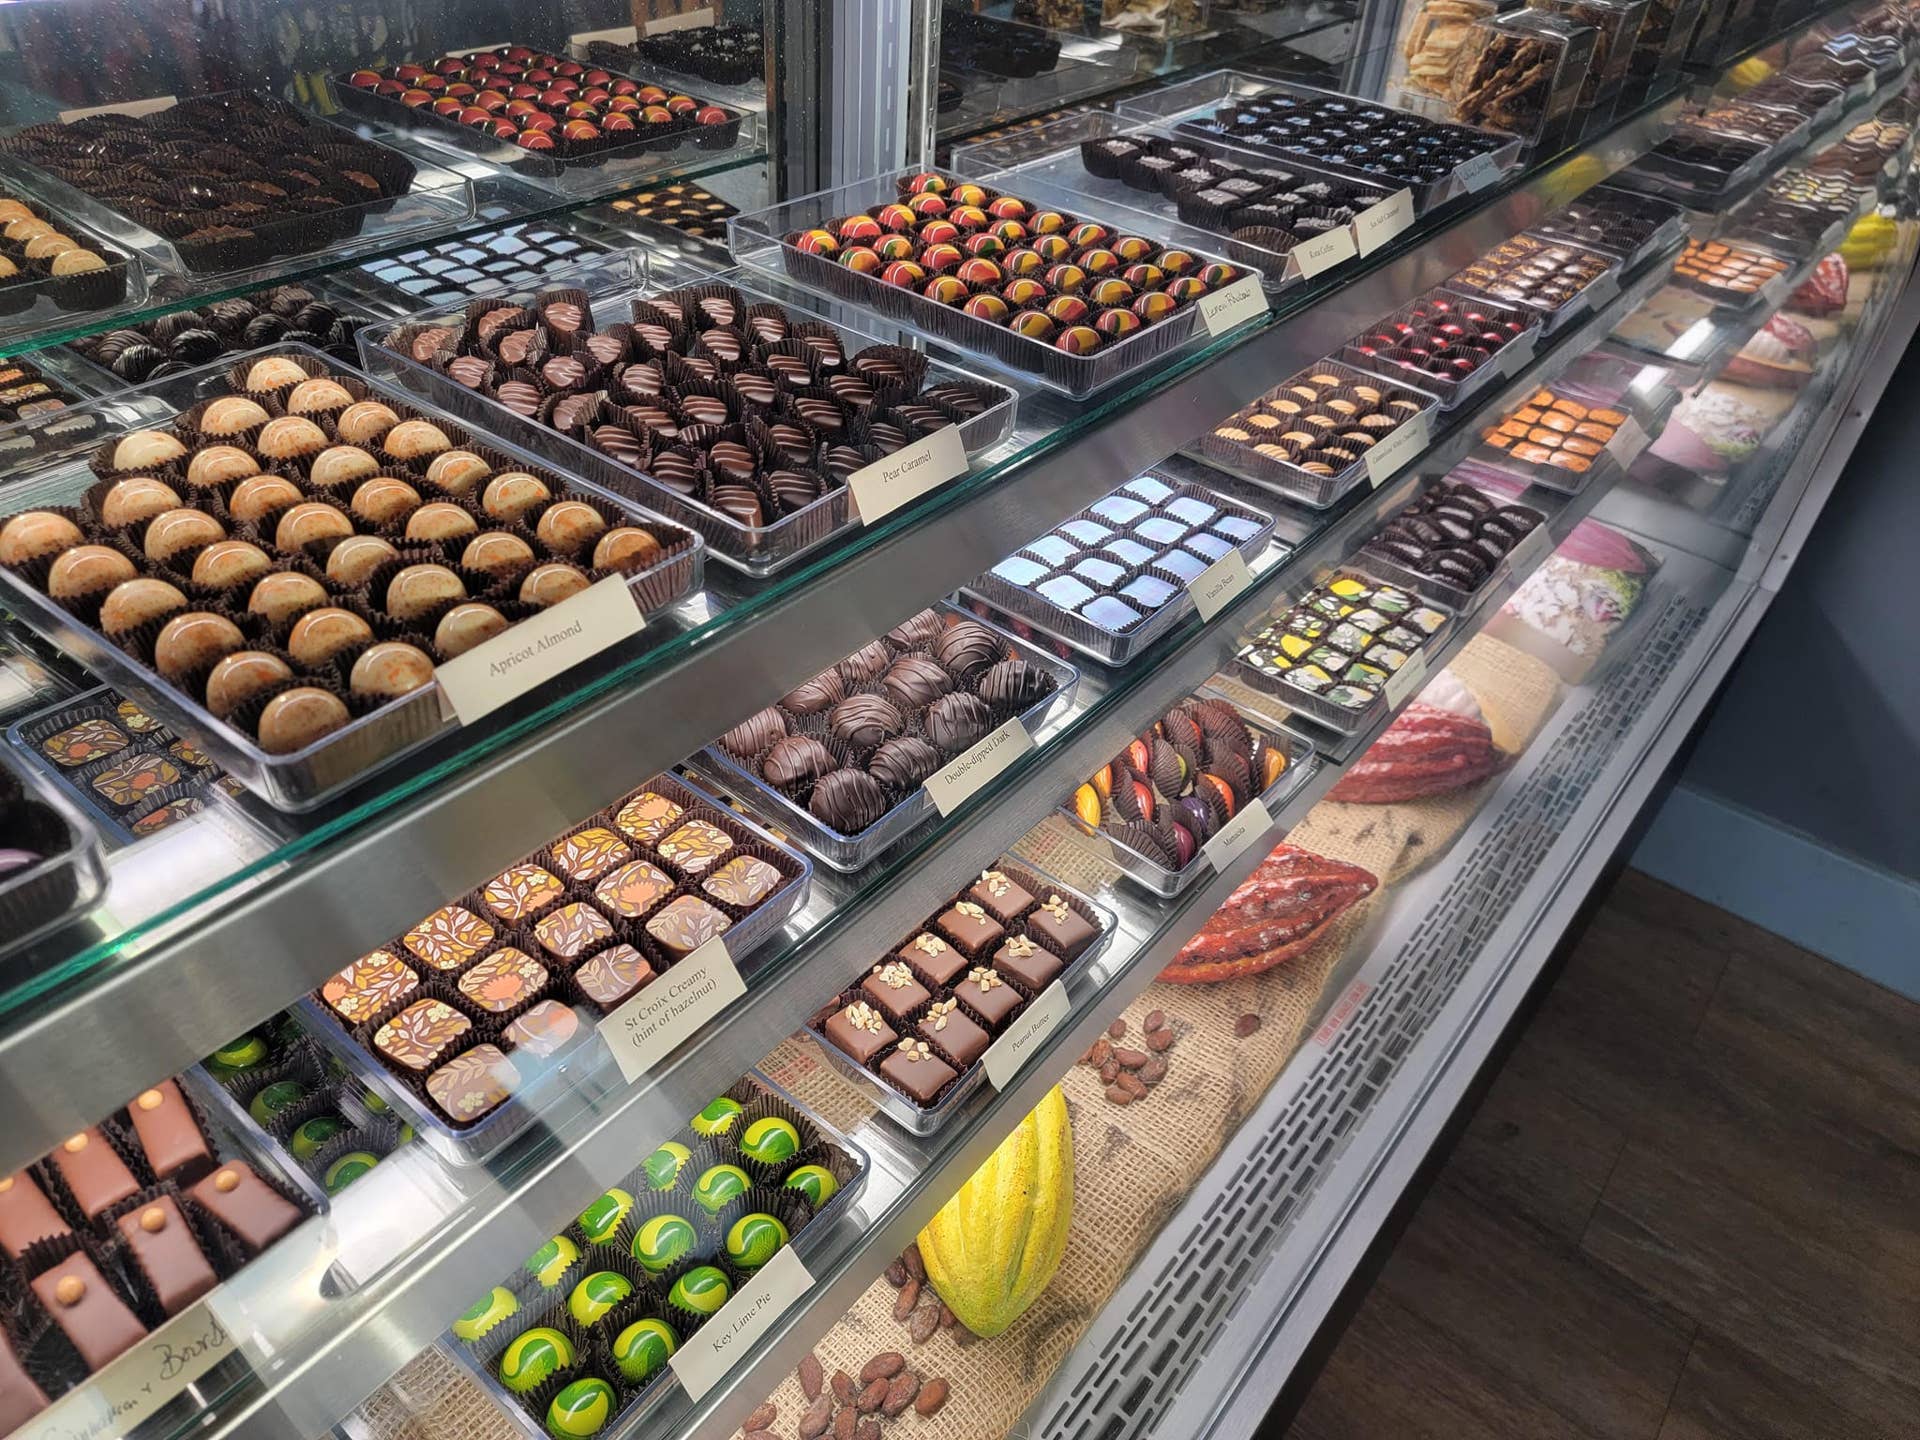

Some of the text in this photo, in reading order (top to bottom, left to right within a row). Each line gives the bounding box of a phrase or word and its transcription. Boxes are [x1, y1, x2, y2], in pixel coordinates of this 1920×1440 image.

[882, 449, 932, 483] Pear Caramel
[490, 620, 582, 677] Apricot Almond
[944, 730, 1010, 784] Double-dipped Dark
[624, 967, 707, 1031] St Croix Creamy
[632, 978, 717, 1048] (hint of hazelnut)
[1011, 1014, 1050, 1052] Peanut Butter
[713, 1292, 772, 1353] Key Lime Pie
